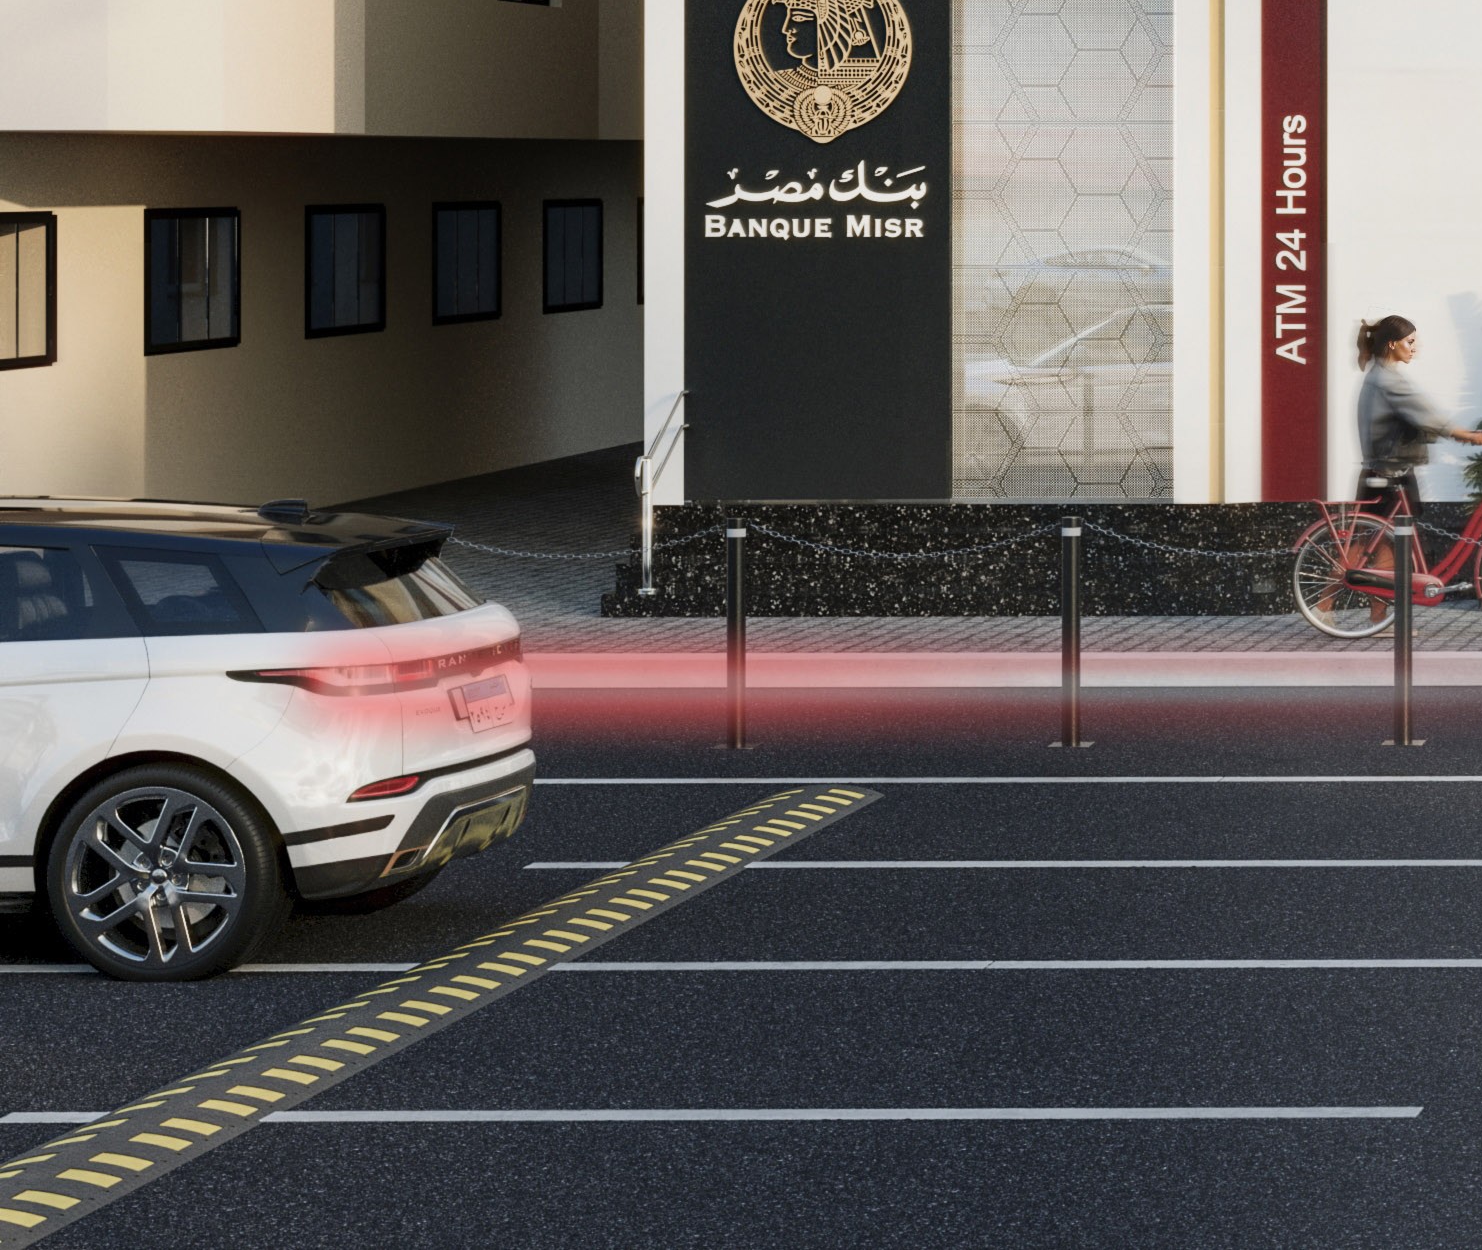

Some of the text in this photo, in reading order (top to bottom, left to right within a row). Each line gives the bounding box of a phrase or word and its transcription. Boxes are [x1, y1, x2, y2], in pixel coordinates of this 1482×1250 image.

[1275, 114, 1307, 365] ATM 24 Hours
